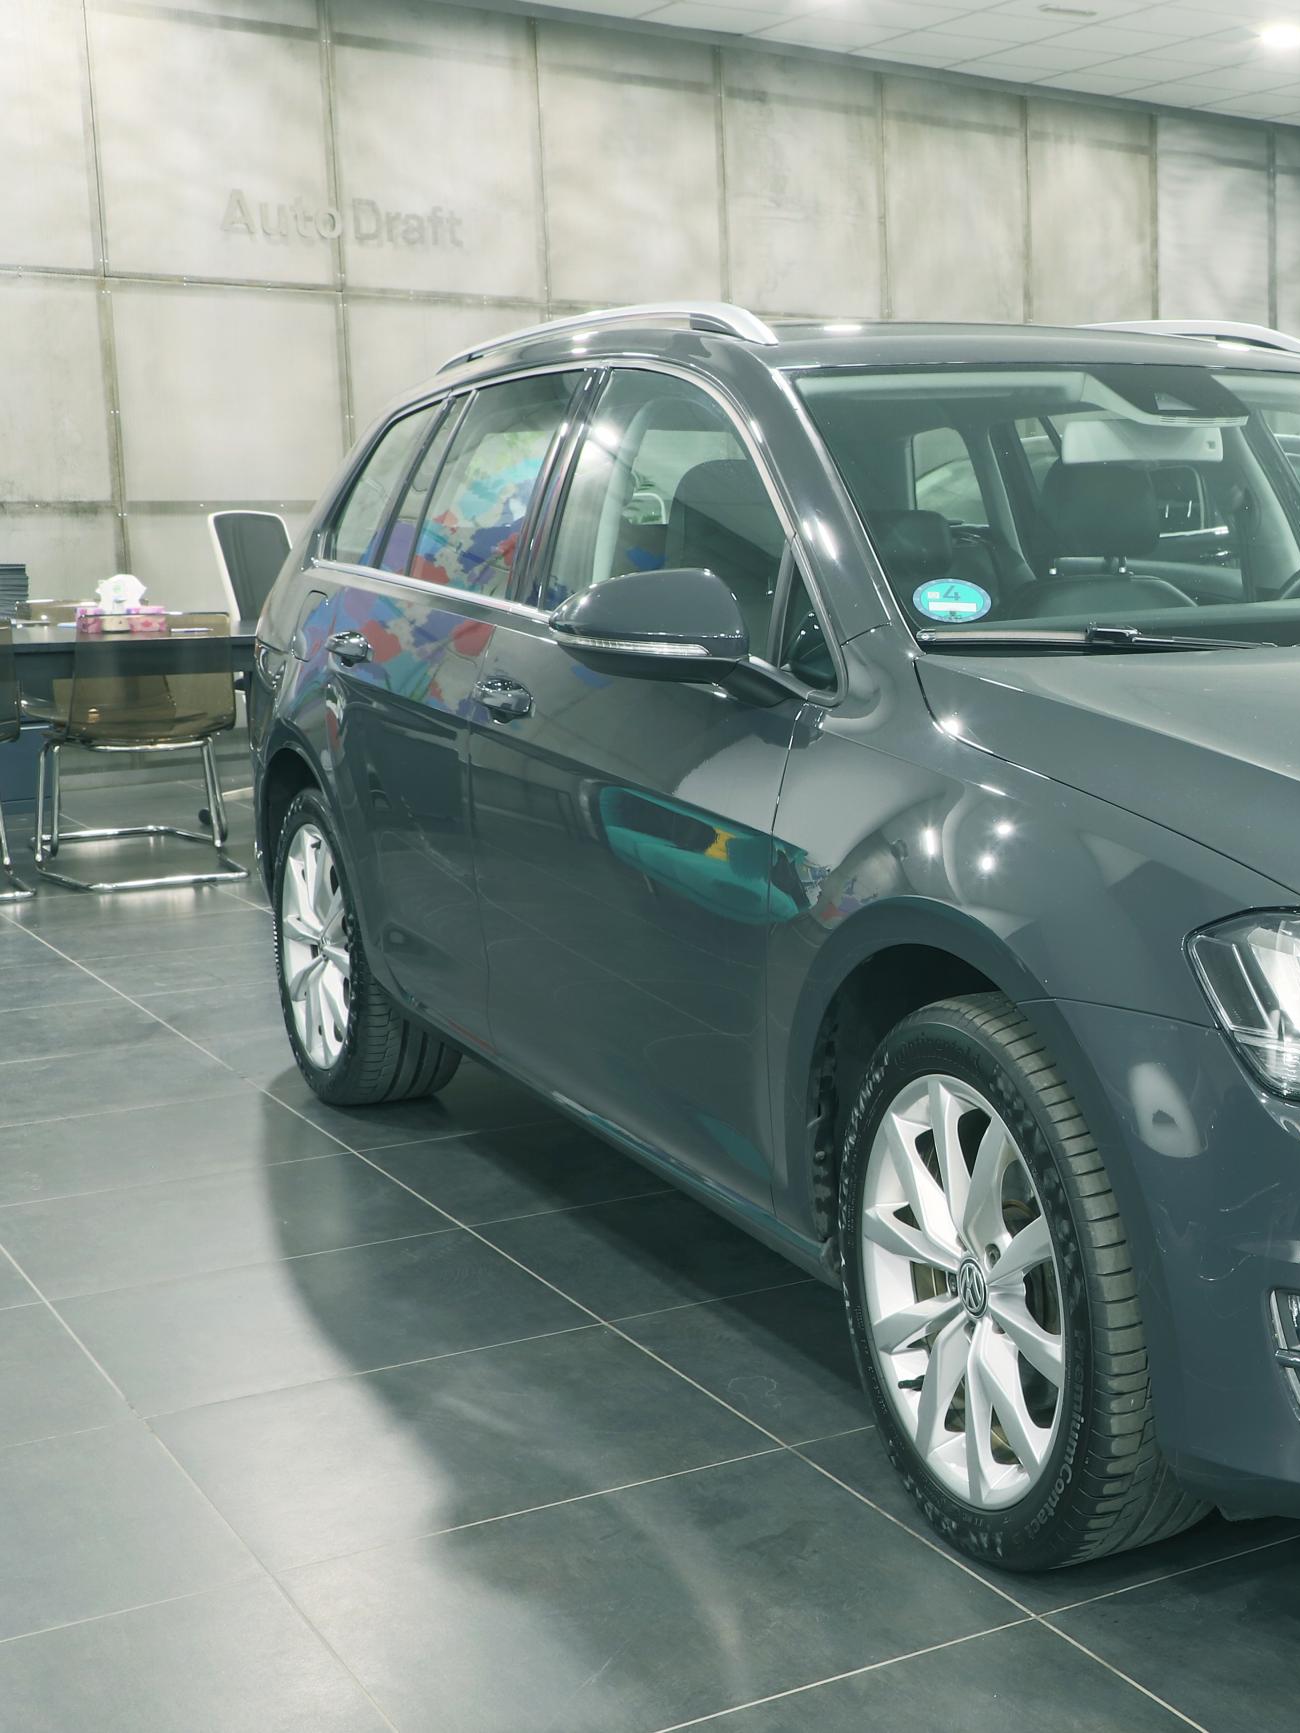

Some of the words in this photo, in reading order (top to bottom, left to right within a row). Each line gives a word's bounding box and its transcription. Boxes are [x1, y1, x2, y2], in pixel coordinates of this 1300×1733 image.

[220, 188, 341, 240] Auto
[352, 198, 464, 248] Draft
[943, 585, 961, 601] 4
